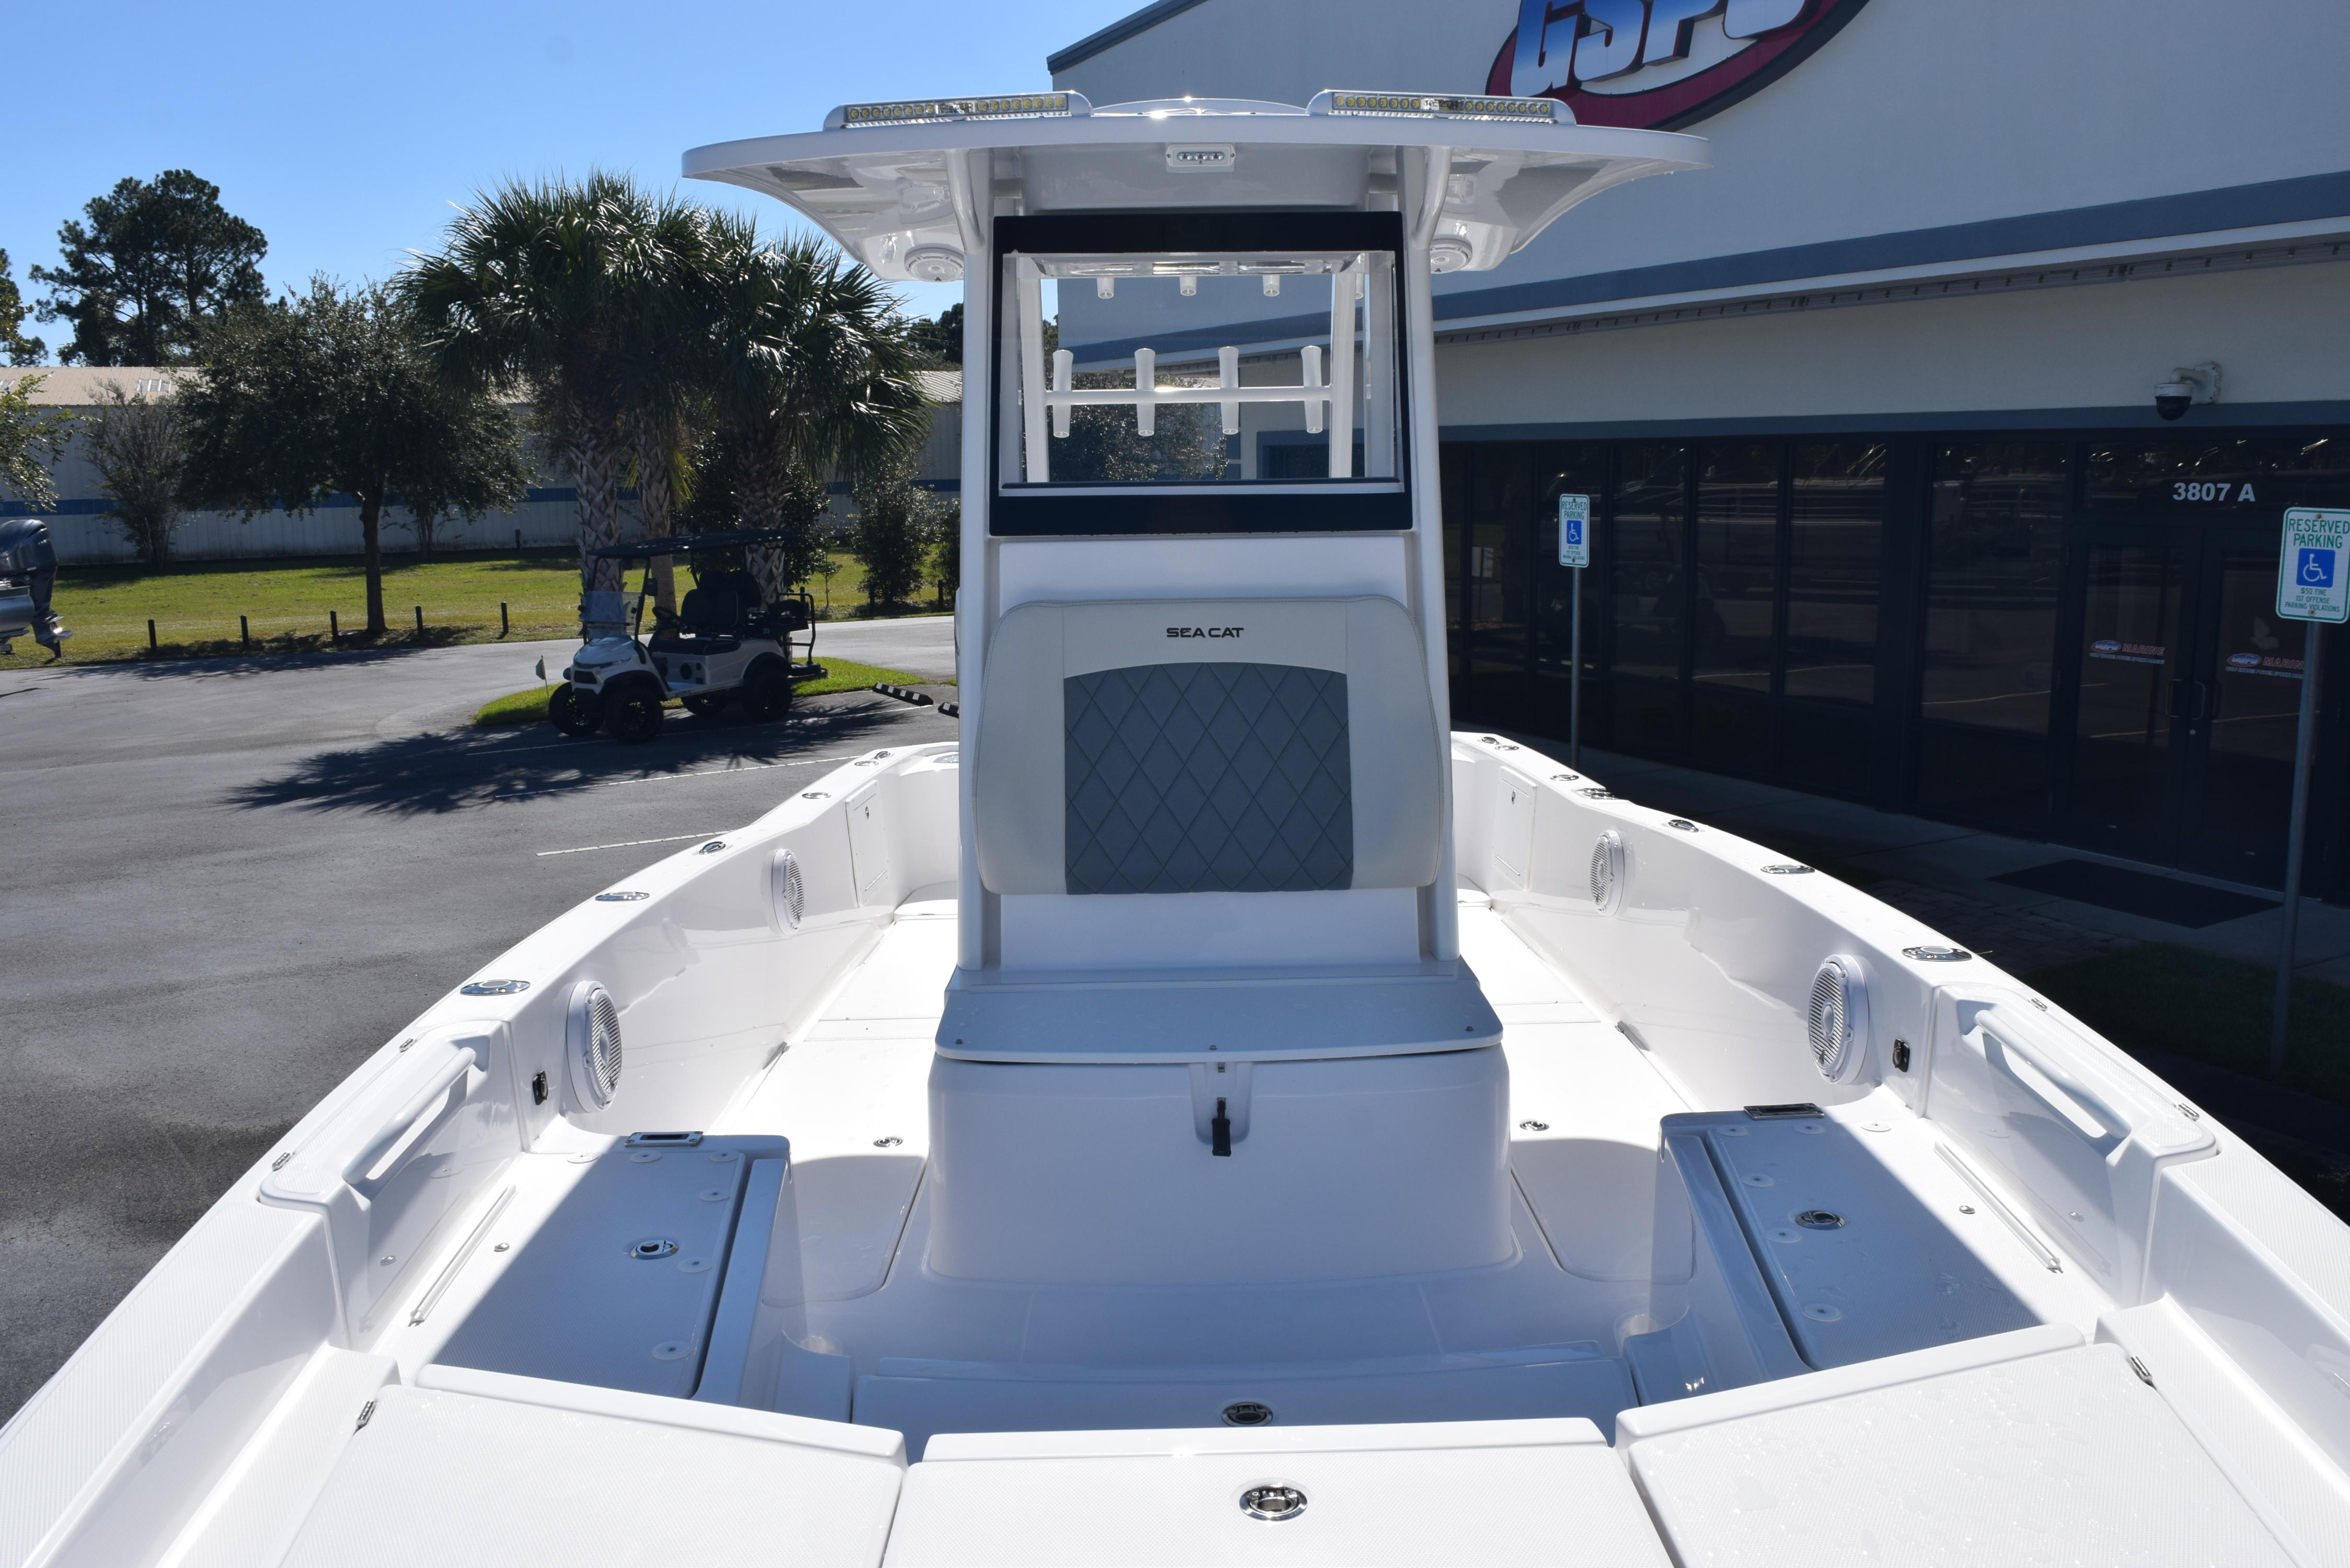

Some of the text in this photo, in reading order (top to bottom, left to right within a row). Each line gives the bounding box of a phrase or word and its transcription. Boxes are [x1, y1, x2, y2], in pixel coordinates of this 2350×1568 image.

[2173, 482, 2255, 502] 3807 A
[1561, 501, 1587, 511] RESERVED
[1564, 511, 1584, 520] PARKING
[2288, 518, 2349, 534] RESERVED
[2293, 533, 2343, 549] PARKING
[2306, 596, 2330, 604] OFFENSE
[2285, 602, 2340, 613] PARKING VIOLATIONS
[1166, 627, 1244, 638] SEA CAT
[2122, 643, 2165, 656] MARINE
[2262, 656, 2305, 670] MARIN
